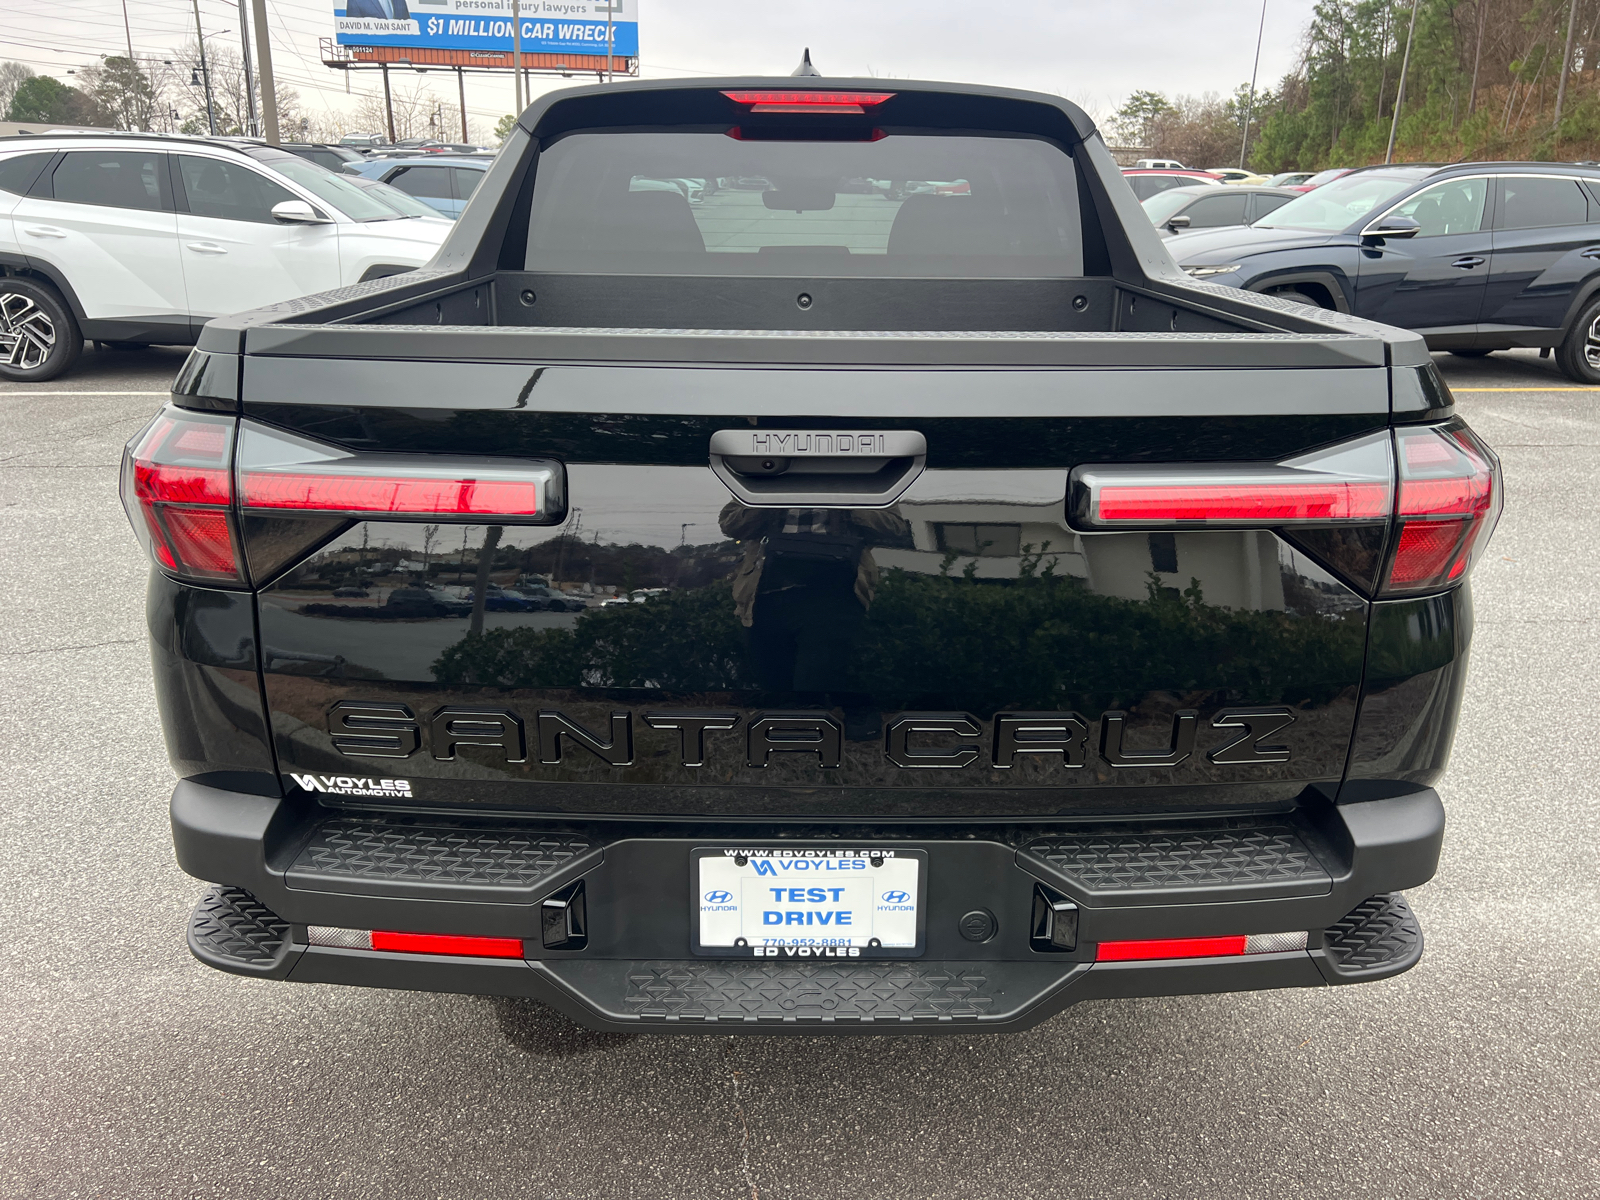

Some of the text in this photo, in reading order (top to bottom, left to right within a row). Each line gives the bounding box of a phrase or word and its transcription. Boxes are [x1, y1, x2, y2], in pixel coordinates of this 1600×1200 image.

[455, 0, 504, 10] personal
[543, 1, 587, 15] lawyers
[339, 21, 411, 31] DAVID M. VAN SANT
[427, 16, 617, 42] $1 MILLION CAR WRECK
[752, 434, 885, 454] HYUNDAI
[326, 700, 1297, 768] SANTA CRUZ
[320, 775, 411, 791] VOYLES
[327, 786, 413, 798] AUTOMOTIVE
[724, 849, 895, 858] WWW.EDVOYLES.COM
[778, 859, 866, 870] VOYLES
[769, 887, 845, 903] TEST
[763, 911, 852, 925] DRIVE
[762, 938, 852, 947] 770-952-8881
[753, 947, 860, 957] ED VOYLES
